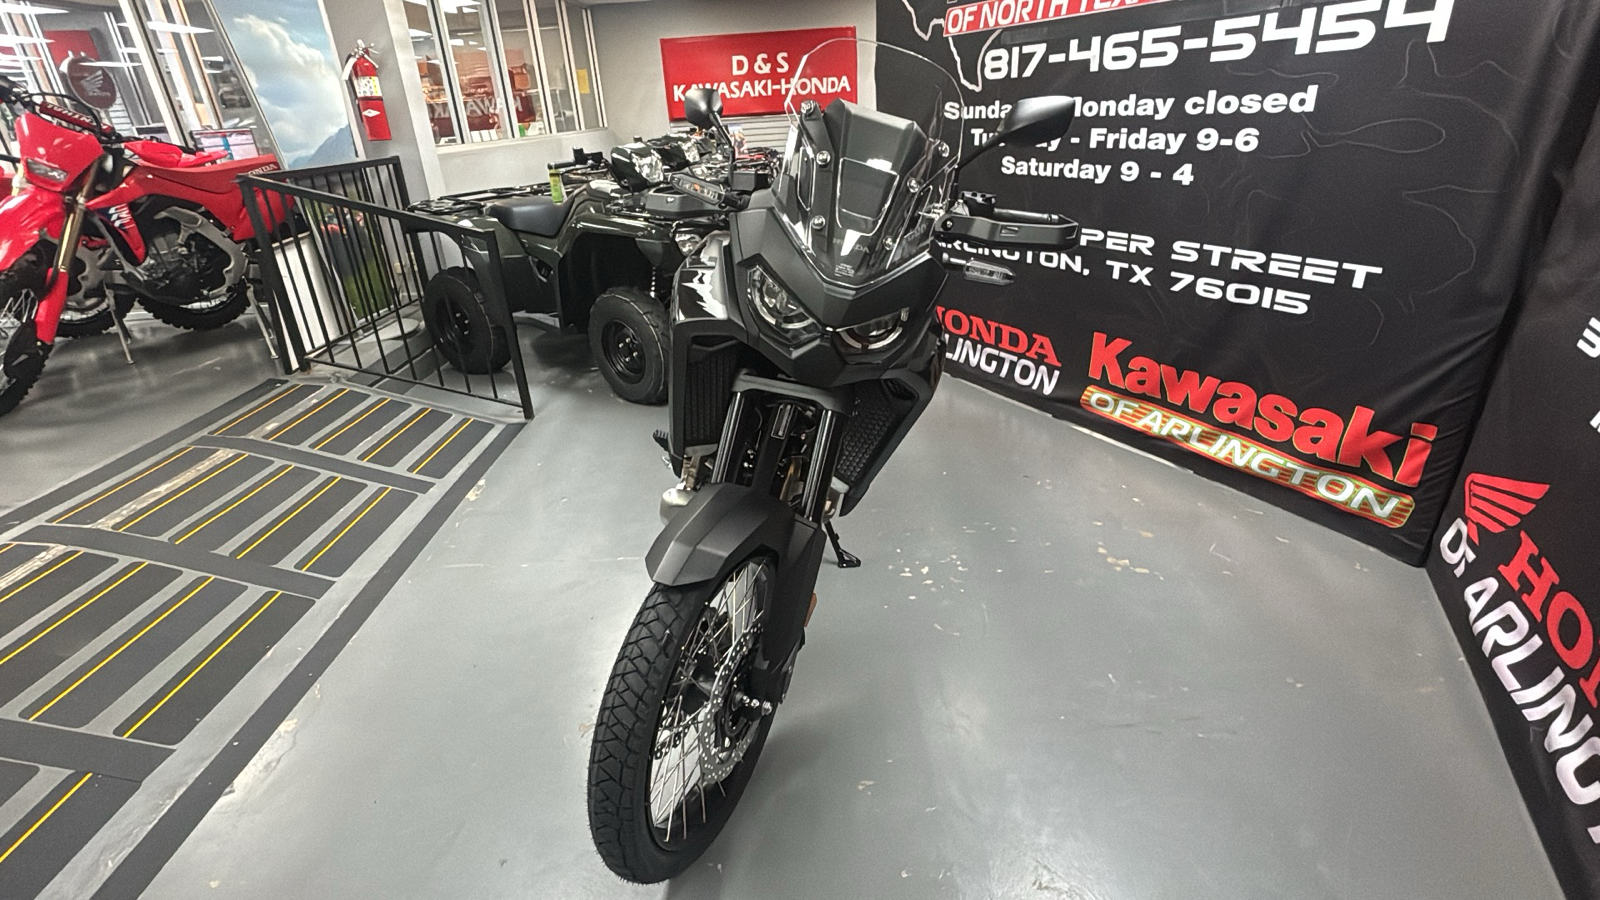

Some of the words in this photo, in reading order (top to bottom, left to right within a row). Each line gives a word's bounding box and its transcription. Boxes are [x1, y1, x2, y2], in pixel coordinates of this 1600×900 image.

[947, 5, 978, 34] OF
[983, 0, 1455, 80] 817-465-5454
[731, 55, 749, 76] D
[753, 53, 772, 74] &
[776, 52, 790, 73] S
[1184, 85, 1319, 115] closed
[1089, 128, 1187, 155] Friday
[1196, 127, 1260, 152] 9-6
[247, 163, 279, 176] ONDA
[1001, 155, 1112, 184] Saturday
[1120, 161, 1140, 182] 9
[1172, 163, 1195, 186] 4
[1171, 240, 1383, 289] STREET
[1106, 260, 1153, 286] TX
[1170, 271, 1311, 315] 76015
[1088, 331, 1438, 488] Kawasaki
[1090, 392, 1139, 418] OF
[1136, 410, 1400, 518] ARLINGTON
